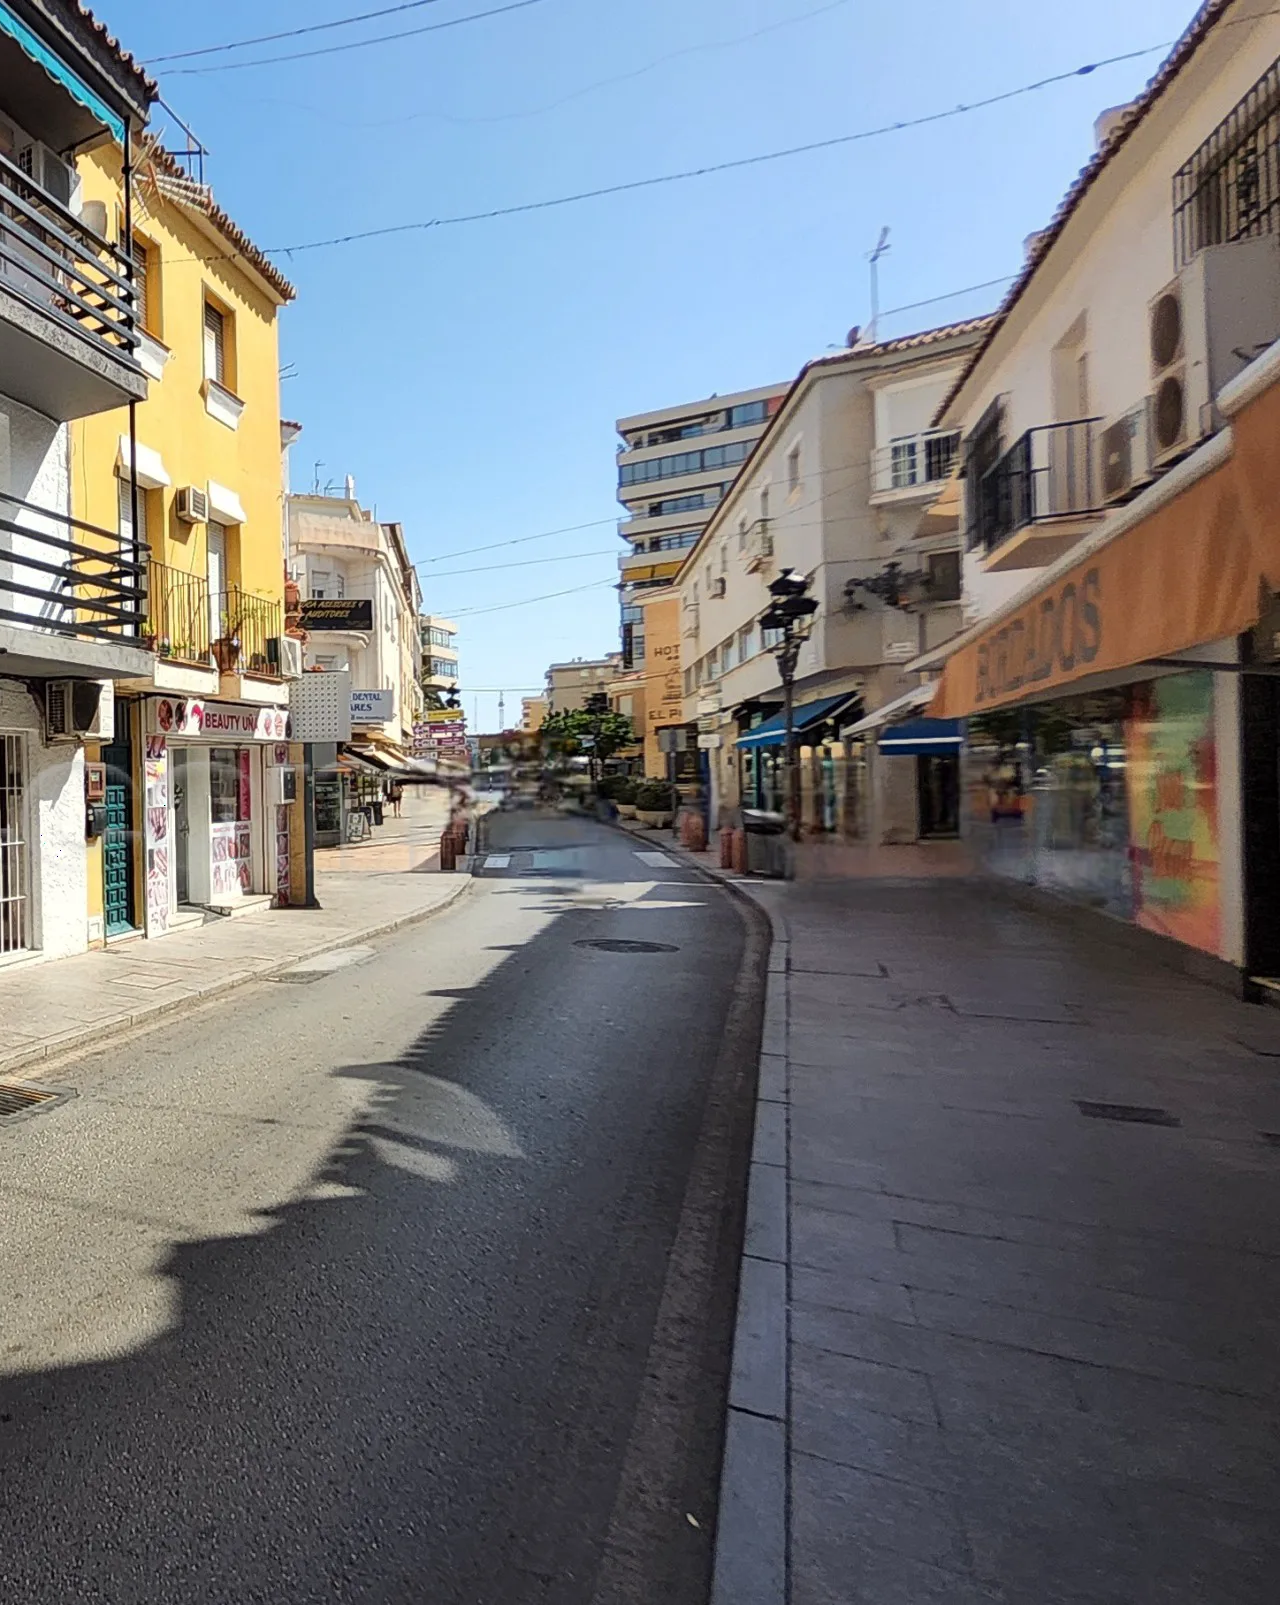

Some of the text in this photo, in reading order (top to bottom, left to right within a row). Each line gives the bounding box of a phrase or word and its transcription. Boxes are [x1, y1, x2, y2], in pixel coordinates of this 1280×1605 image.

[306, 609, 351, 618] AUDITORES
[352, 692, 382, 701] DENTAL
[648, 709, 666, 720] EL
[204, 712, 240, 731] BEAUTY
